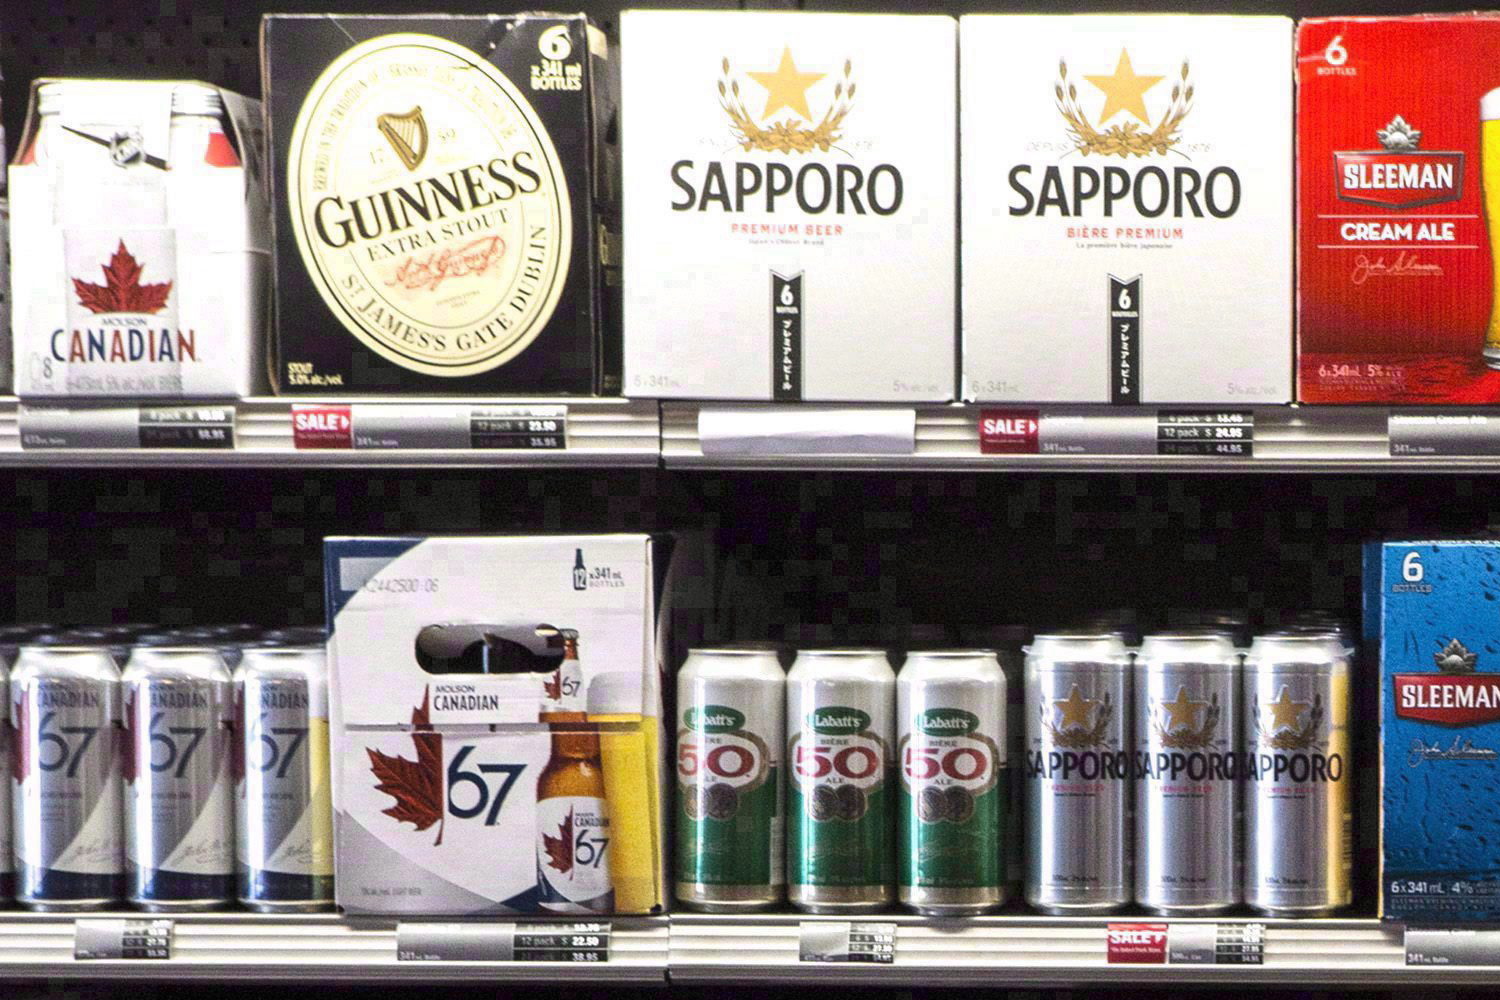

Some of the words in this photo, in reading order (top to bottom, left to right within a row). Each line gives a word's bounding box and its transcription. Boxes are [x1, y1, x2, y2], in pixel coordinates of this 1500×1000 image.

[538, 26, 572, 60] 6
[1325, 35, 1348, 64] 6
[531, 78, 582, 90] BOTTLES
[670, 159, 903, 216] SAPPORO
[1008, 164, 1241, 219] SAPPORO
[1343, 162, 1454, 192] SLEEMAN
[314, 152, 540, 248] GUINNESS
[368, 230, 436, 261] EXTRA
[442, 208, 510, 237] STOUT
[731, 223, 798, 236] PREMIUM
[805, 224, 844, 237] BEER
[1067, 226, 1108, 239] BIÈRE
[1116, 228, 1183, 239] PREMIUM
[1340, 223, 1414, 242] CREAM
[1418, 223, 1455, 241] ALE
[456, 313, 514, 352] GATE
[510, 224, 546, 314] DUBLIN
[780, 285, 794, 305] 6
[51, 330, 195, 362] CANADIAN
[296, 414, 338, 430] SALE
[983, 419, 1025, 434] SALE
[1402, 552, 1424, 581] 6
[434, 695, 498, 710] CANADIAN
[436, 685, 475, 693] MOLSON
[795, 746, 877, 779] 50
[905, 747, 987, 780] 50
[1248, 752, 1342, 782] APPORO
[448, 746, 527, 826] 67
[576, 830, 609, 868] 67
